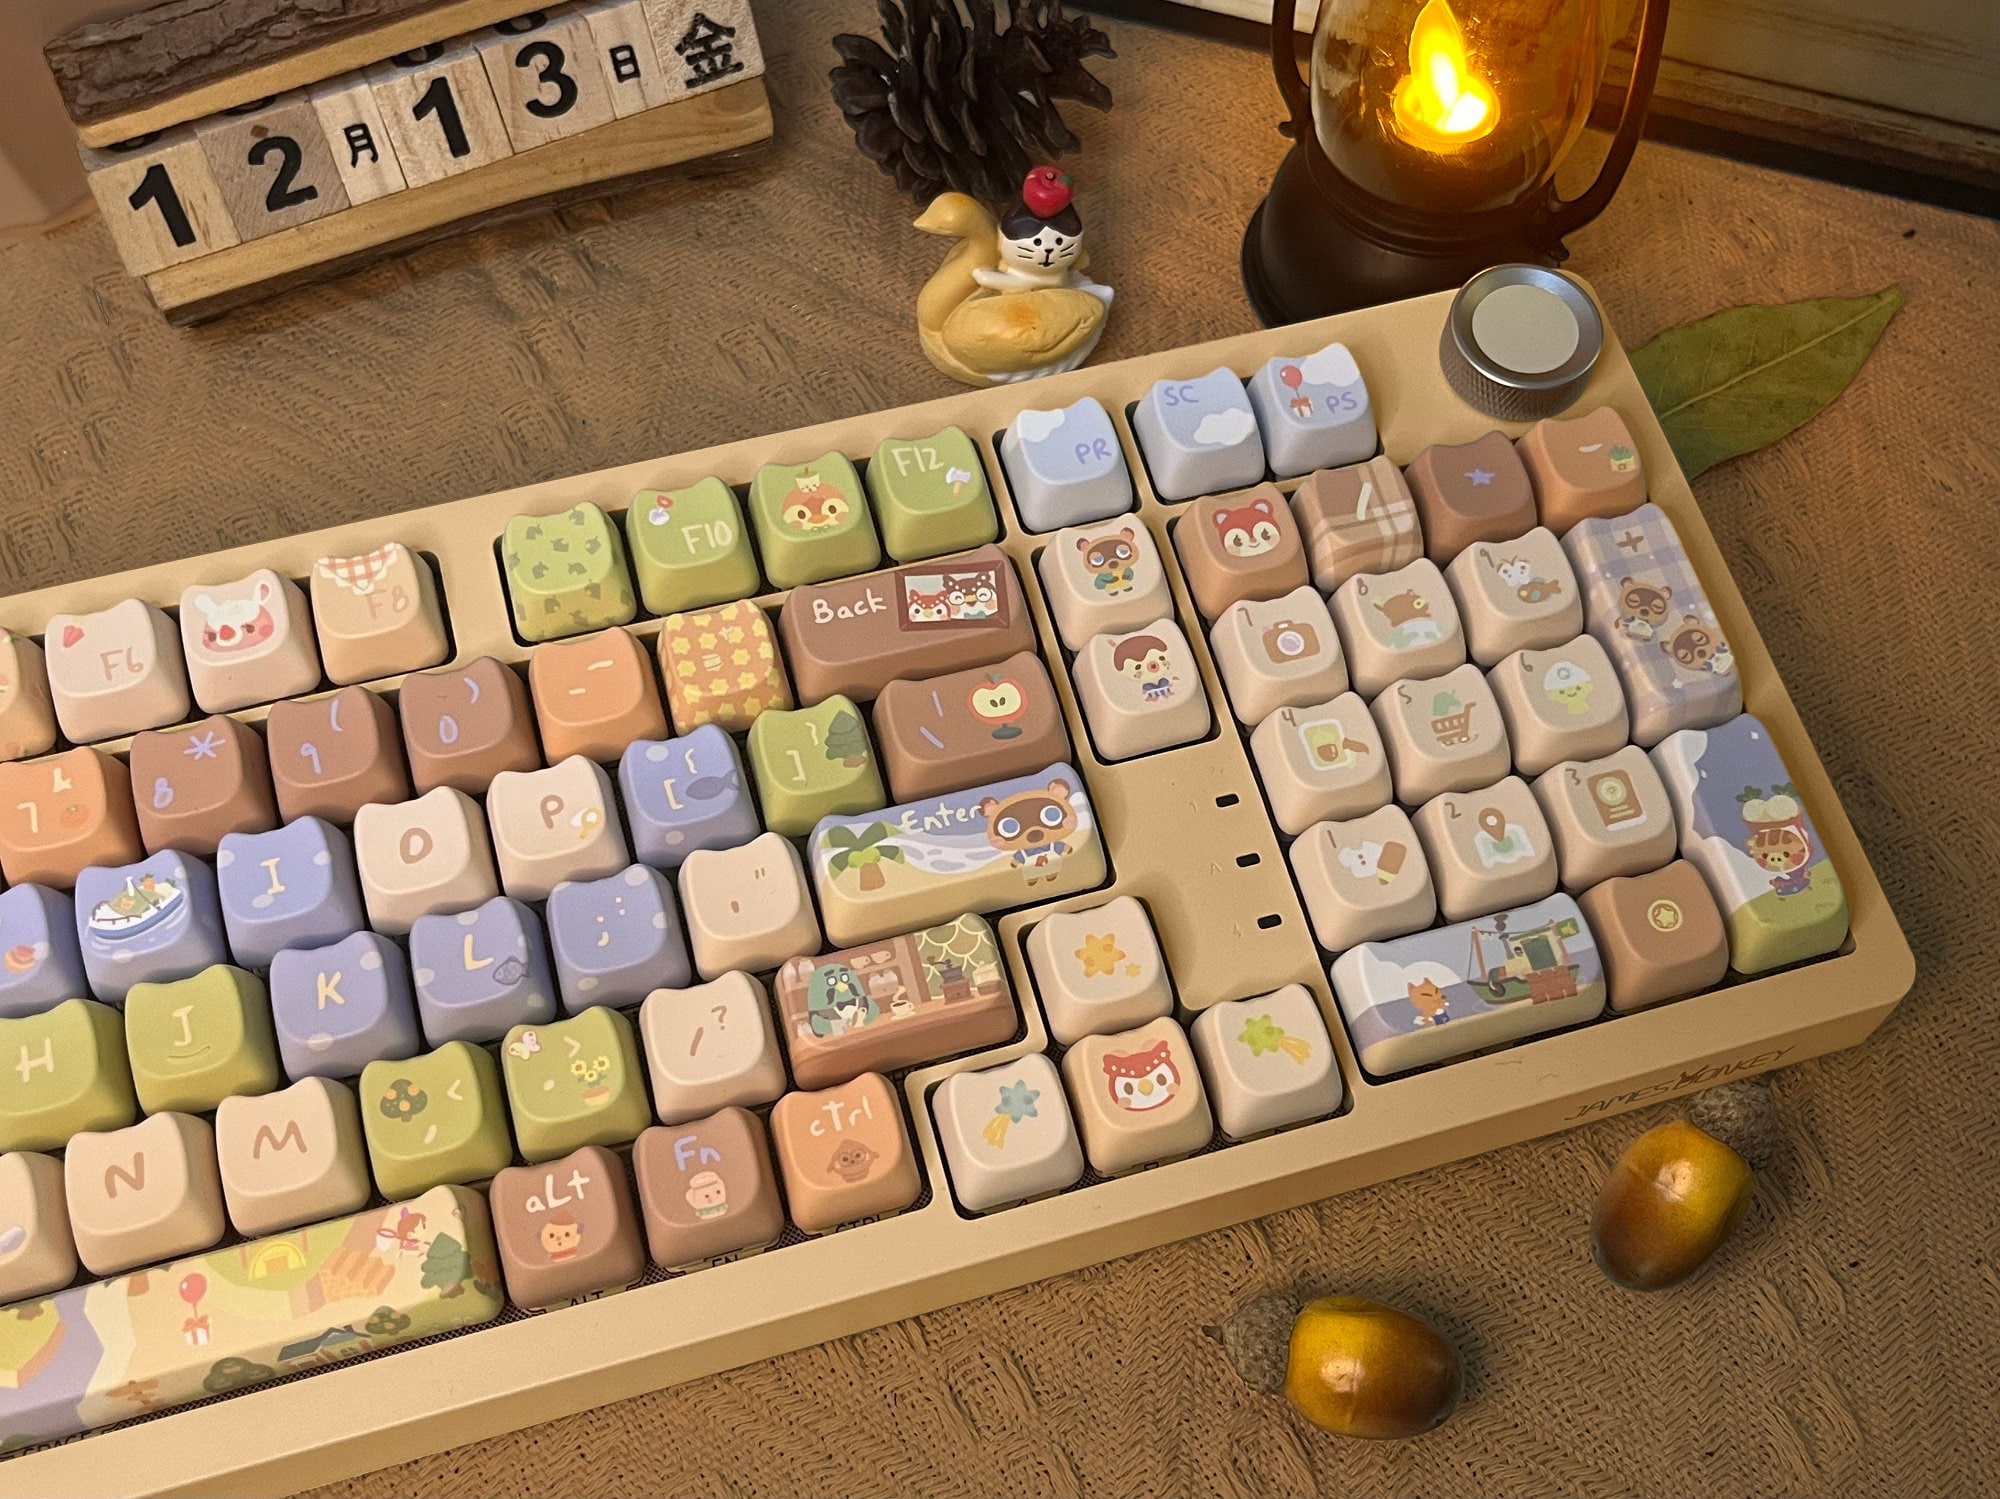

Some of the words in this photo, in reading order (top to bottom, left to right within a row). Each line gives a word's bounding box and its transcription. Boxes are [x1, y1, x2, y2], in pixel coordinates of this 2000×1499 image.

[1163, 385, 1200, 407] SC
[1325, 391, 1358, 415] PS
[891, 446, 945, 478] F12
[1075, 437, 1112, 464] PR
[680, 519, 734, 554] F10
[365, 584, 409, 620] F8
[811, 589, 887, 625] Back
[100, 647, 144, 681] F6
[540, 795, 565, 829] P
[900, 803, 983, 836] Enter
[260, 857, 286, 895] I
[464, 934, 494, 971] L
[317, 971, 344, 1010] K
[172, 1005, 195, 1046] J
[15, 1038, 55, 1082] H
[253, 1120, 308, 1160] M
[673, 1135, 720, 1171] Fn
[104, 1152, 145, 1198] N
